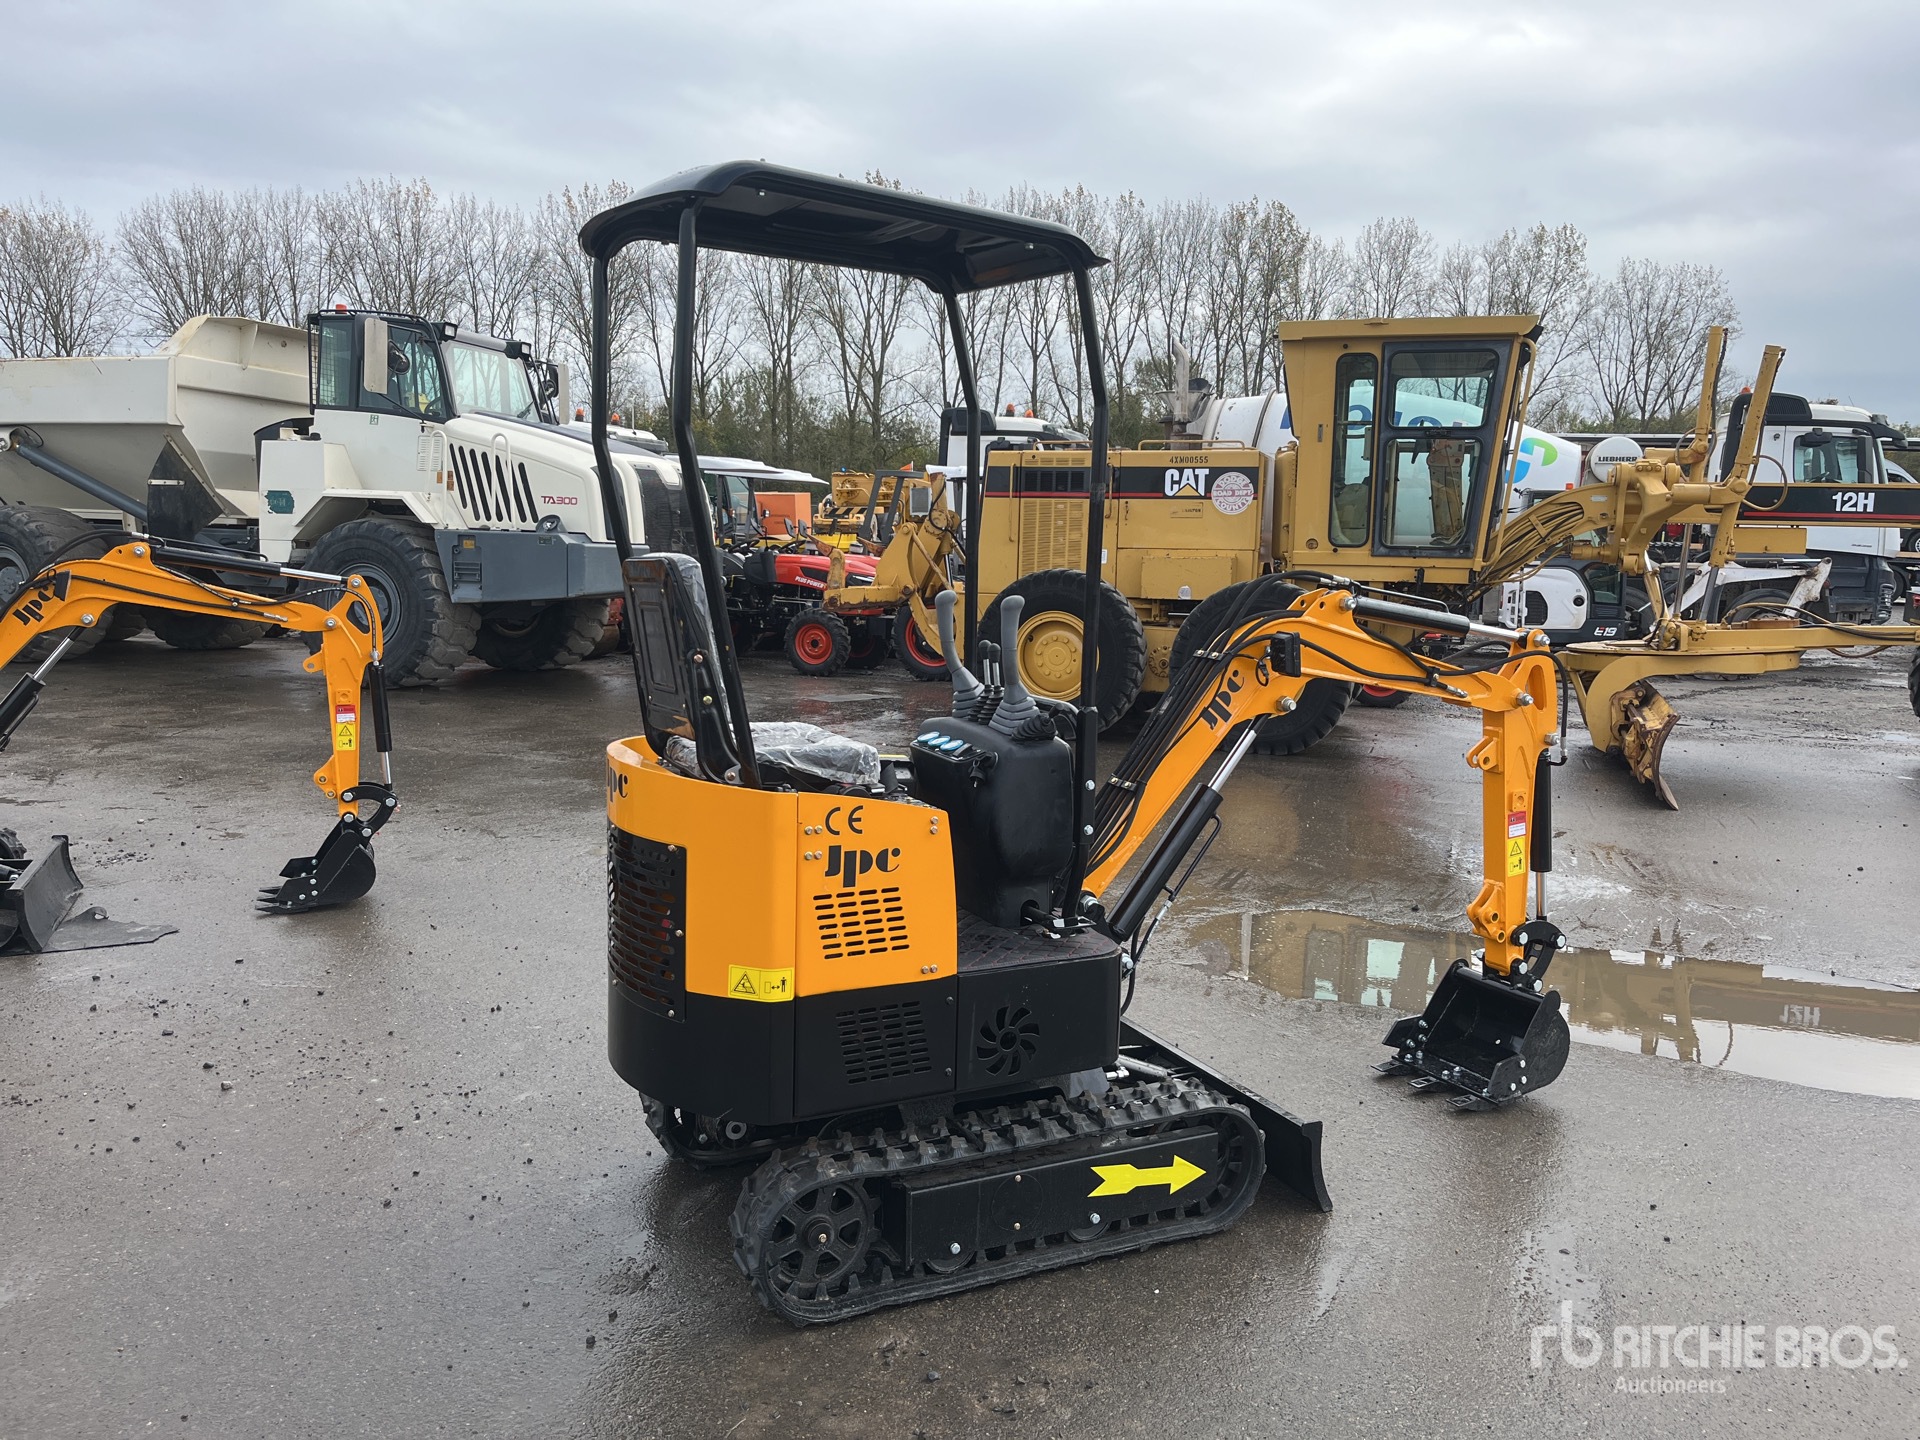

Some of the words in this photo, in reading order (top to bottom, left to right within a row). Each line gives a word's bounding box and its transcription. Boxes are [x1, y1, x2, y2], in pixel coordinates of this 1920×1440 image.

[1169, 455, 1209, 464] 4XM00555
[1164, 468, 1210, 497] CAT
[1218, 475, 1247, 487] DODGE
[541, 495, 578, 505] TA300
[1216, 497, 1249, 511] COUNTY
[1831, 491, 1876, 512] 12H
[1593, 626, 1618, 637] E19
